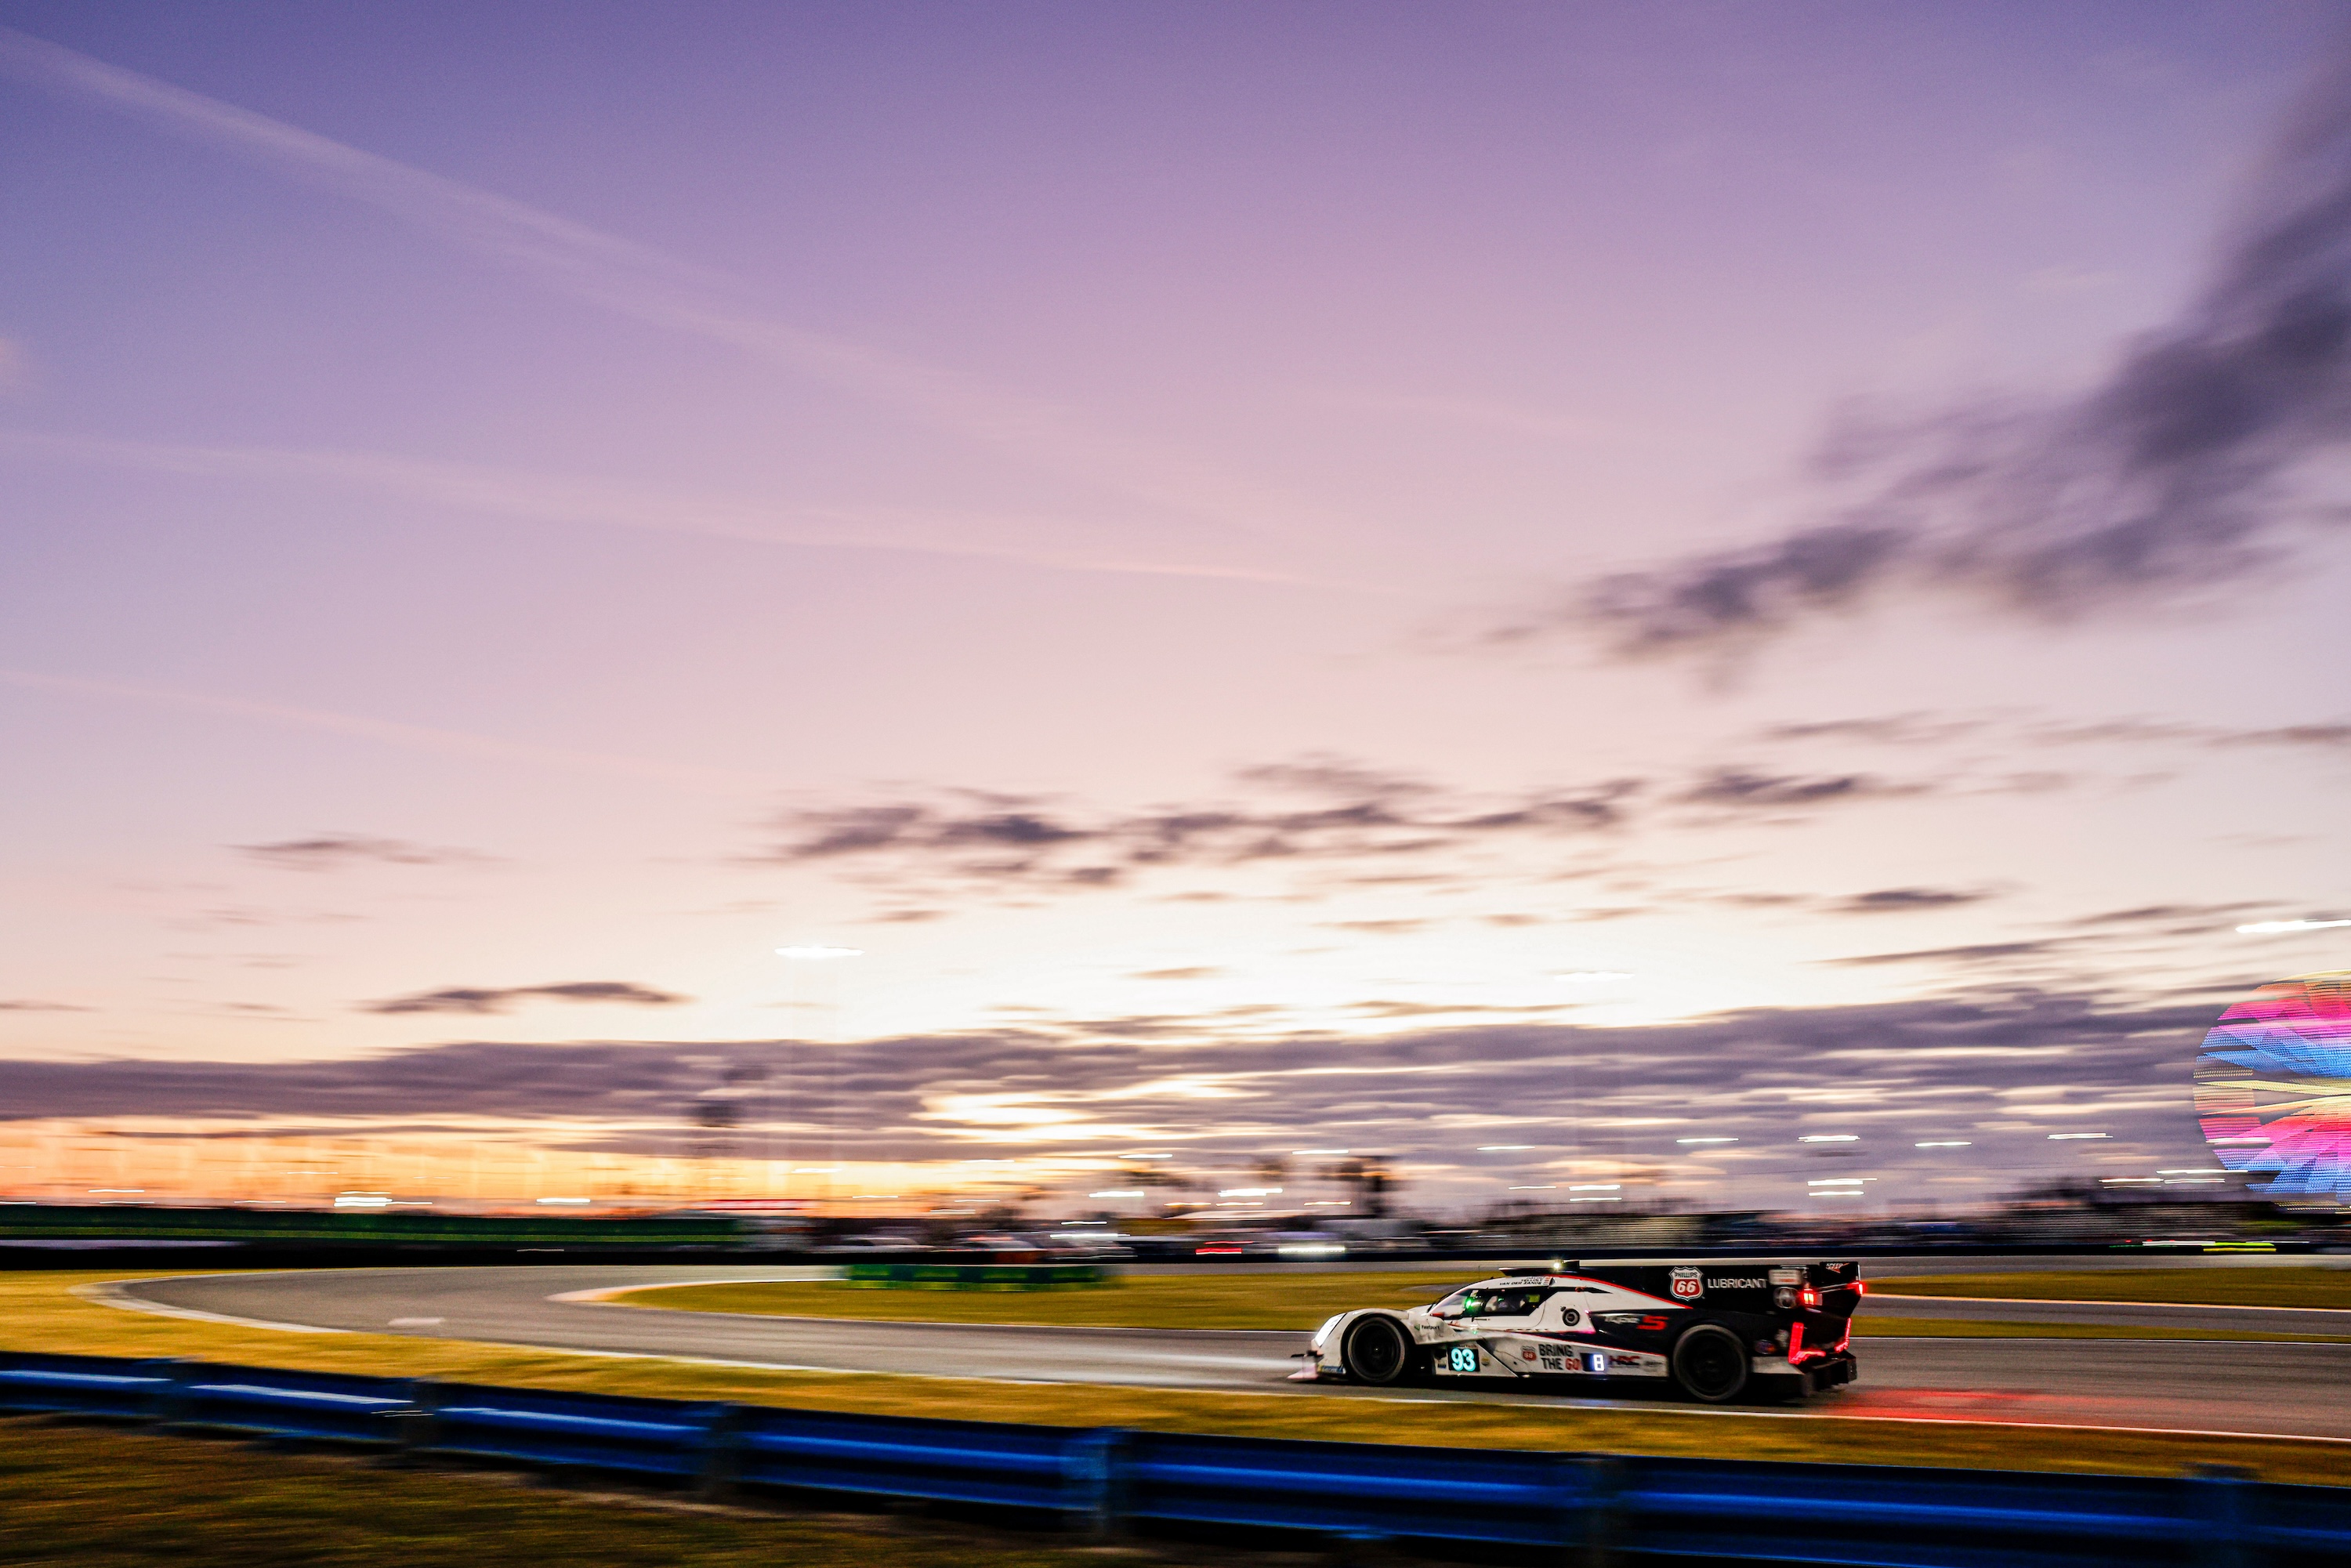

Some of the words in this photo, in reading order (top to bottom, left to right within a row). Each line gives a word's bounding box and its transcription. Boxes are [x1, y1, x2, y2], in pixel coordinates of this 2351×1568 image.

[1676, 1280, 1697, 1293] 66
[1538, 1344, 1574, 1357] BRING
[1451, 1348, 1476, 1372] 93
[1541, 1357, 1563, 1370] THE
[1565, 1358, 1581, 1371] GO
[1593, 1354, 1605, 1371] 8
